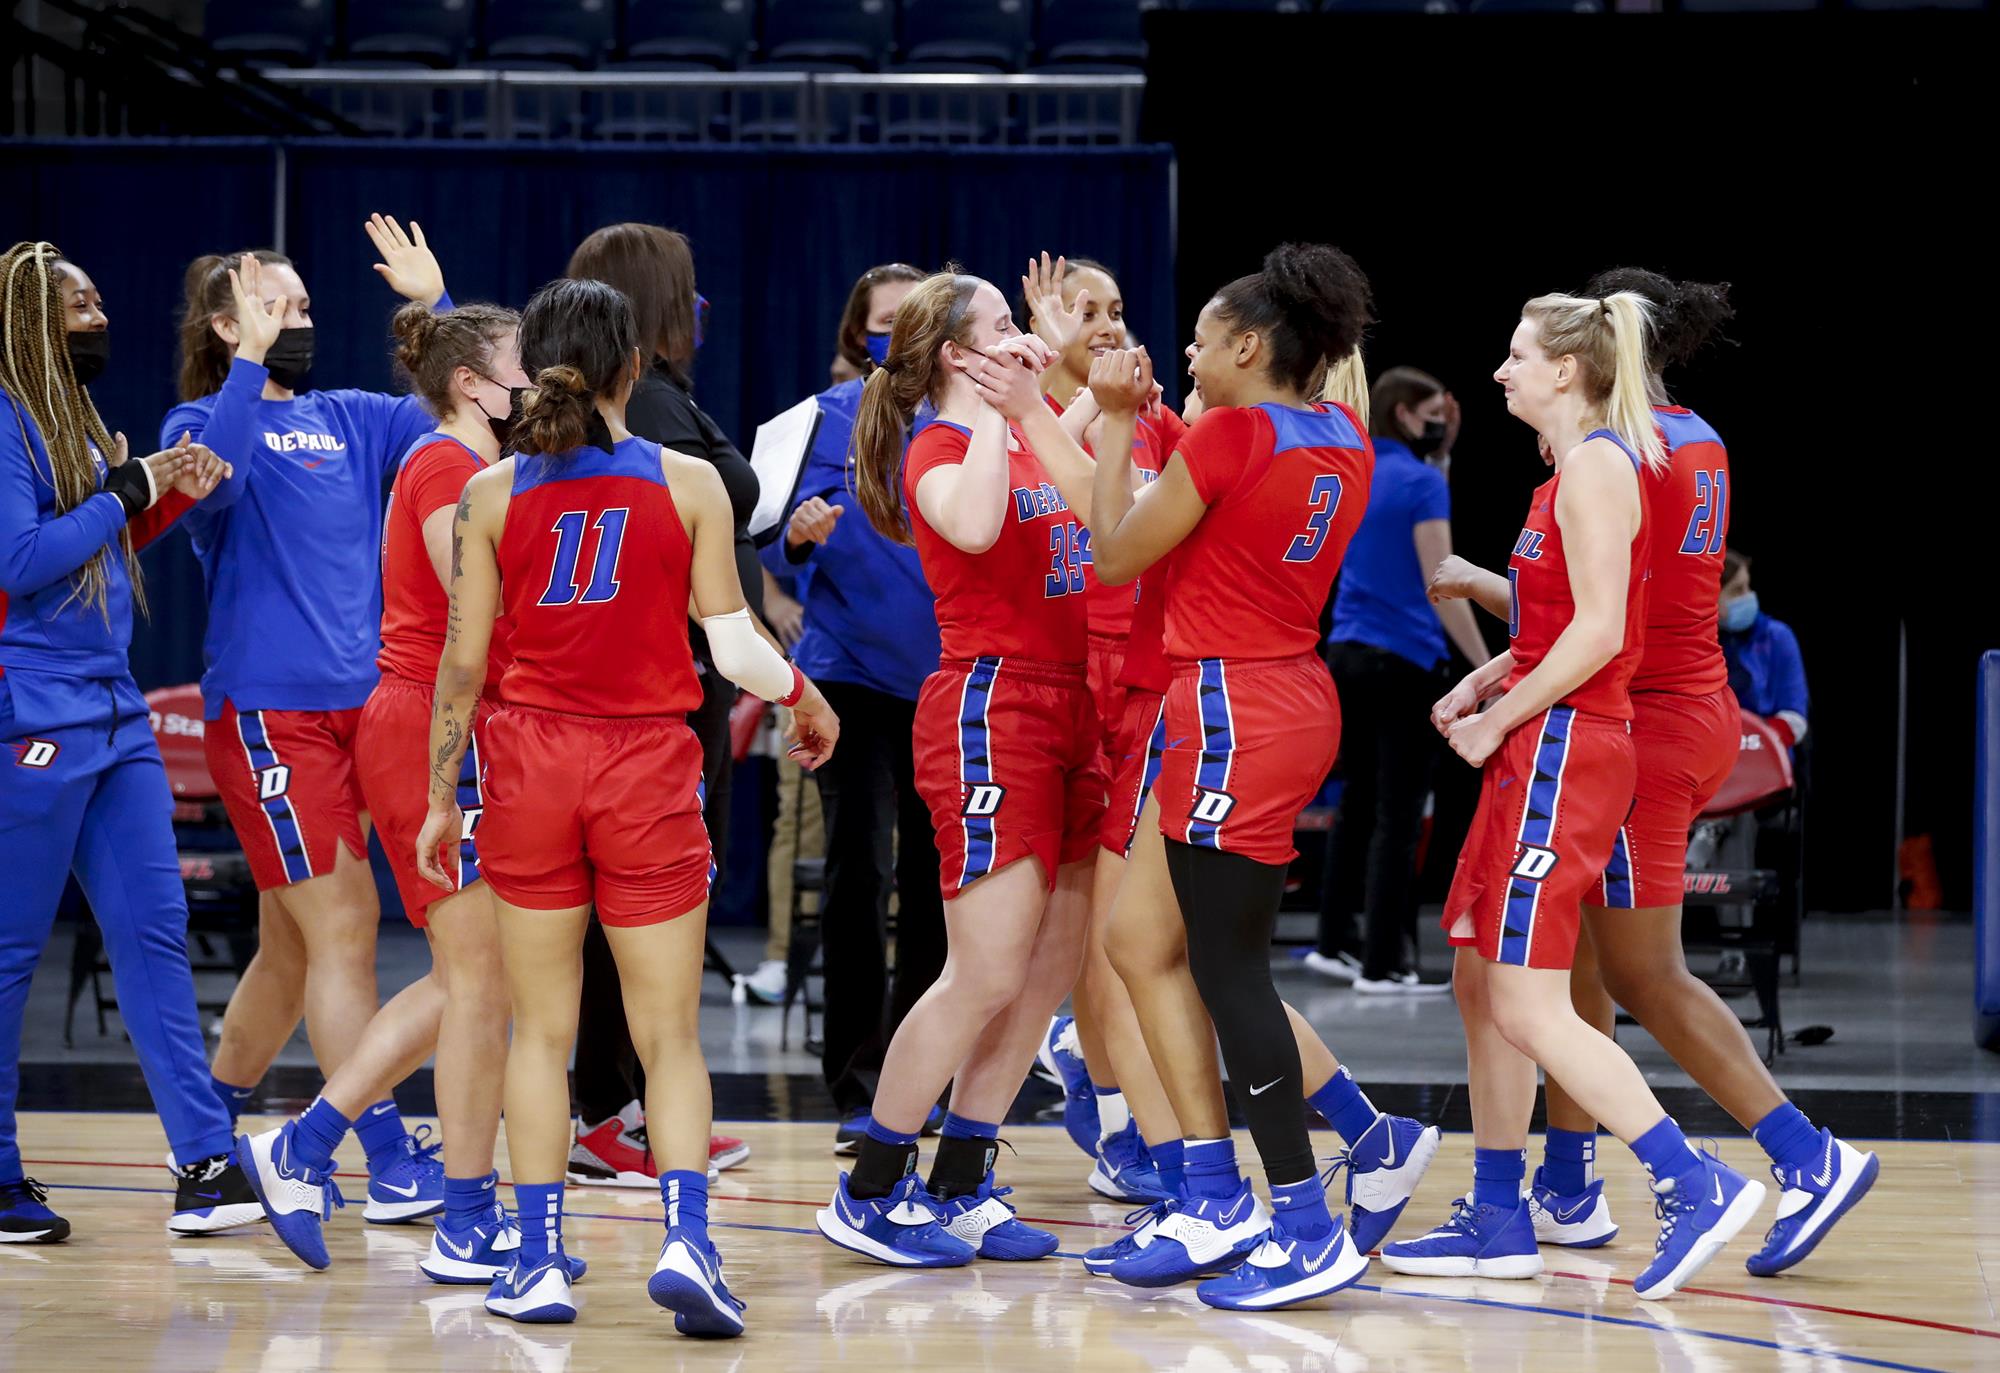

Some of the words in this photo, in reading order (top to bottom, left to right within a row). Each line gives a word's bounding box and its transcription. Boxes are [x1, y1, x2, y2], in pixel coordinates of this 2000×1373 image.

[1282, 474, 1343, 562] 3
[1678, 469, 1727, 555] 21
[537, 507, 629, 606] 11
[1044, 521, 1085, 599] 35
[20, 739, 58, 768] D
[259, 763, 291, 800] D
[964, 785, 1004, 816] D
[1191, 790, 1234, 823] D
[1512, 846, 1557, 879] D
